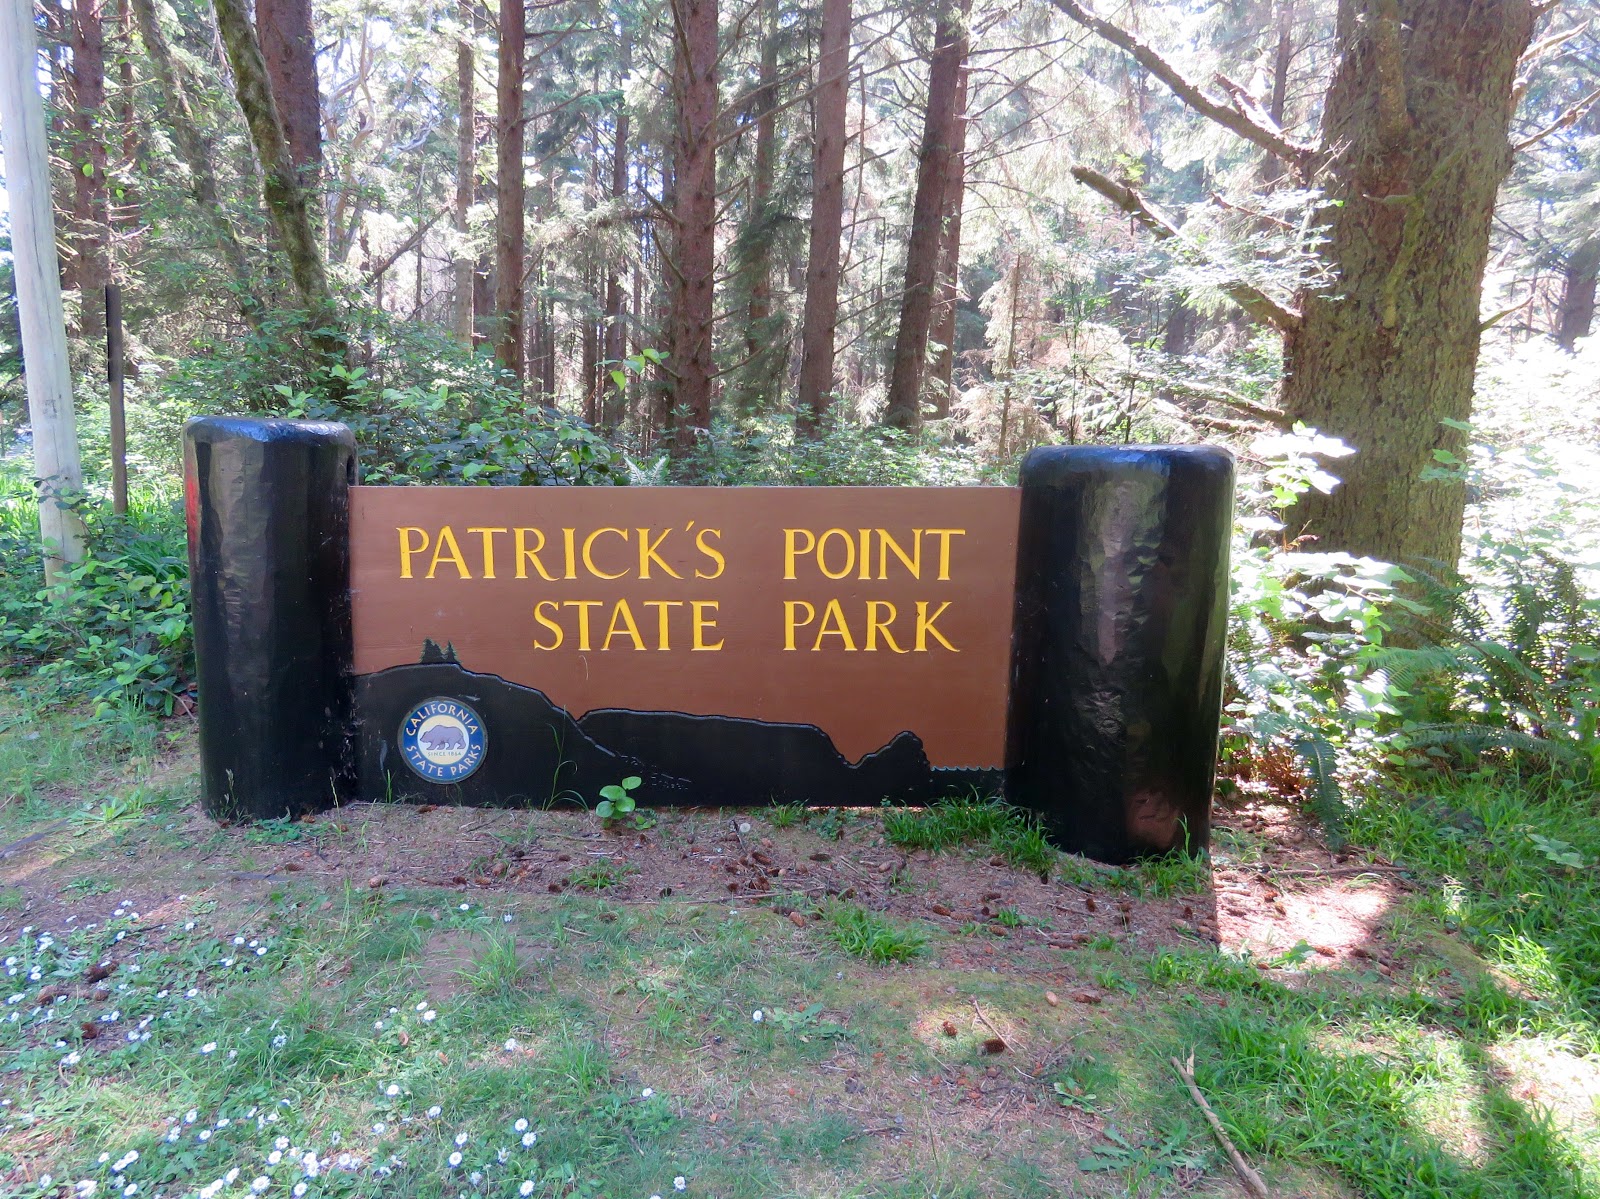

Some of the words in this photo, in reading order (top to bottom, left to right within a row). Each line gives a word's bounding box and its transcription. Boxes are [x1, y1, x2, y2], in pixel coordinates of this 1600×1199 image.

[396, 520, 726, 581] PATRICK'S
[783, 528, 966, 581] POINT
[533, 599, 725, 652] STATE
[783, 600, 961, 654] PARK
[406, 703, 478, 736] CALIFORNIA
[406, 745, 443, 777] STATE
[450, 744, 481, 776] PARKS
